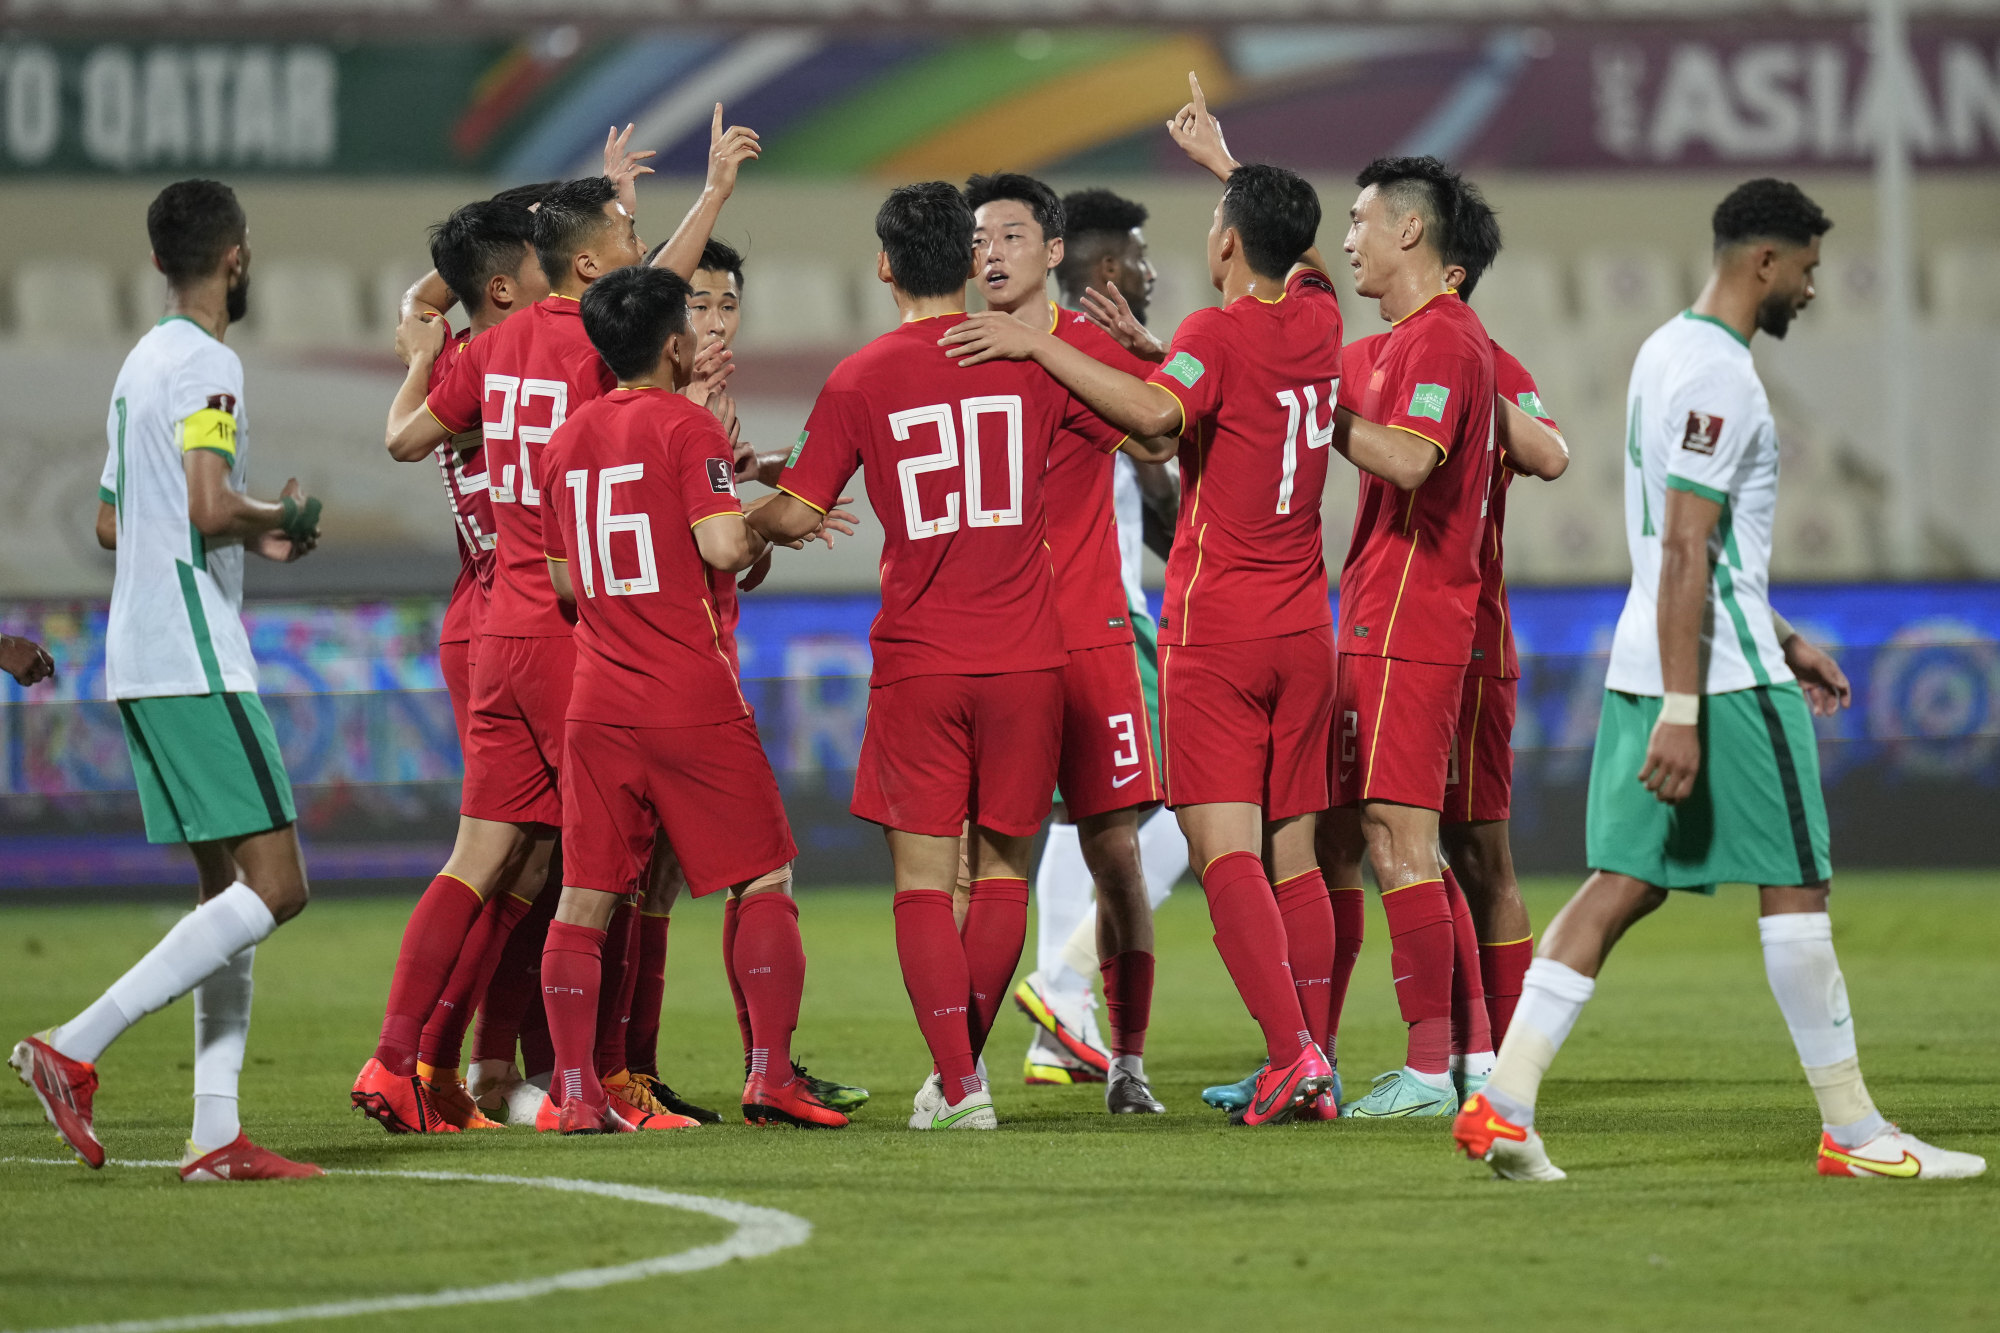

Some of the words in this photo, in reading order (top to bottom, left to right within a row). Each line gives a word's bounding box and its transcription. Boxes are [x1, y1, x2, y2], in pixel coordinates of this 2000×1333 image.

[0, 46, 60, 162] O
[83, 46, 336, 166] QATAR
[482, 373, 568, 505] 22
[888, 394, 1023, 541] 20
[1276, 377, 1340, 515] 14
[565, 463, 660, 598] 16
[1108, 712, 1139, 767] 3
[1341, 710, 1358, 762] 2
[545, 986, 583, 996] CFA
[933, 1006, 967, 1017] CFA
[1295, 977, 1331, 987] CFA
